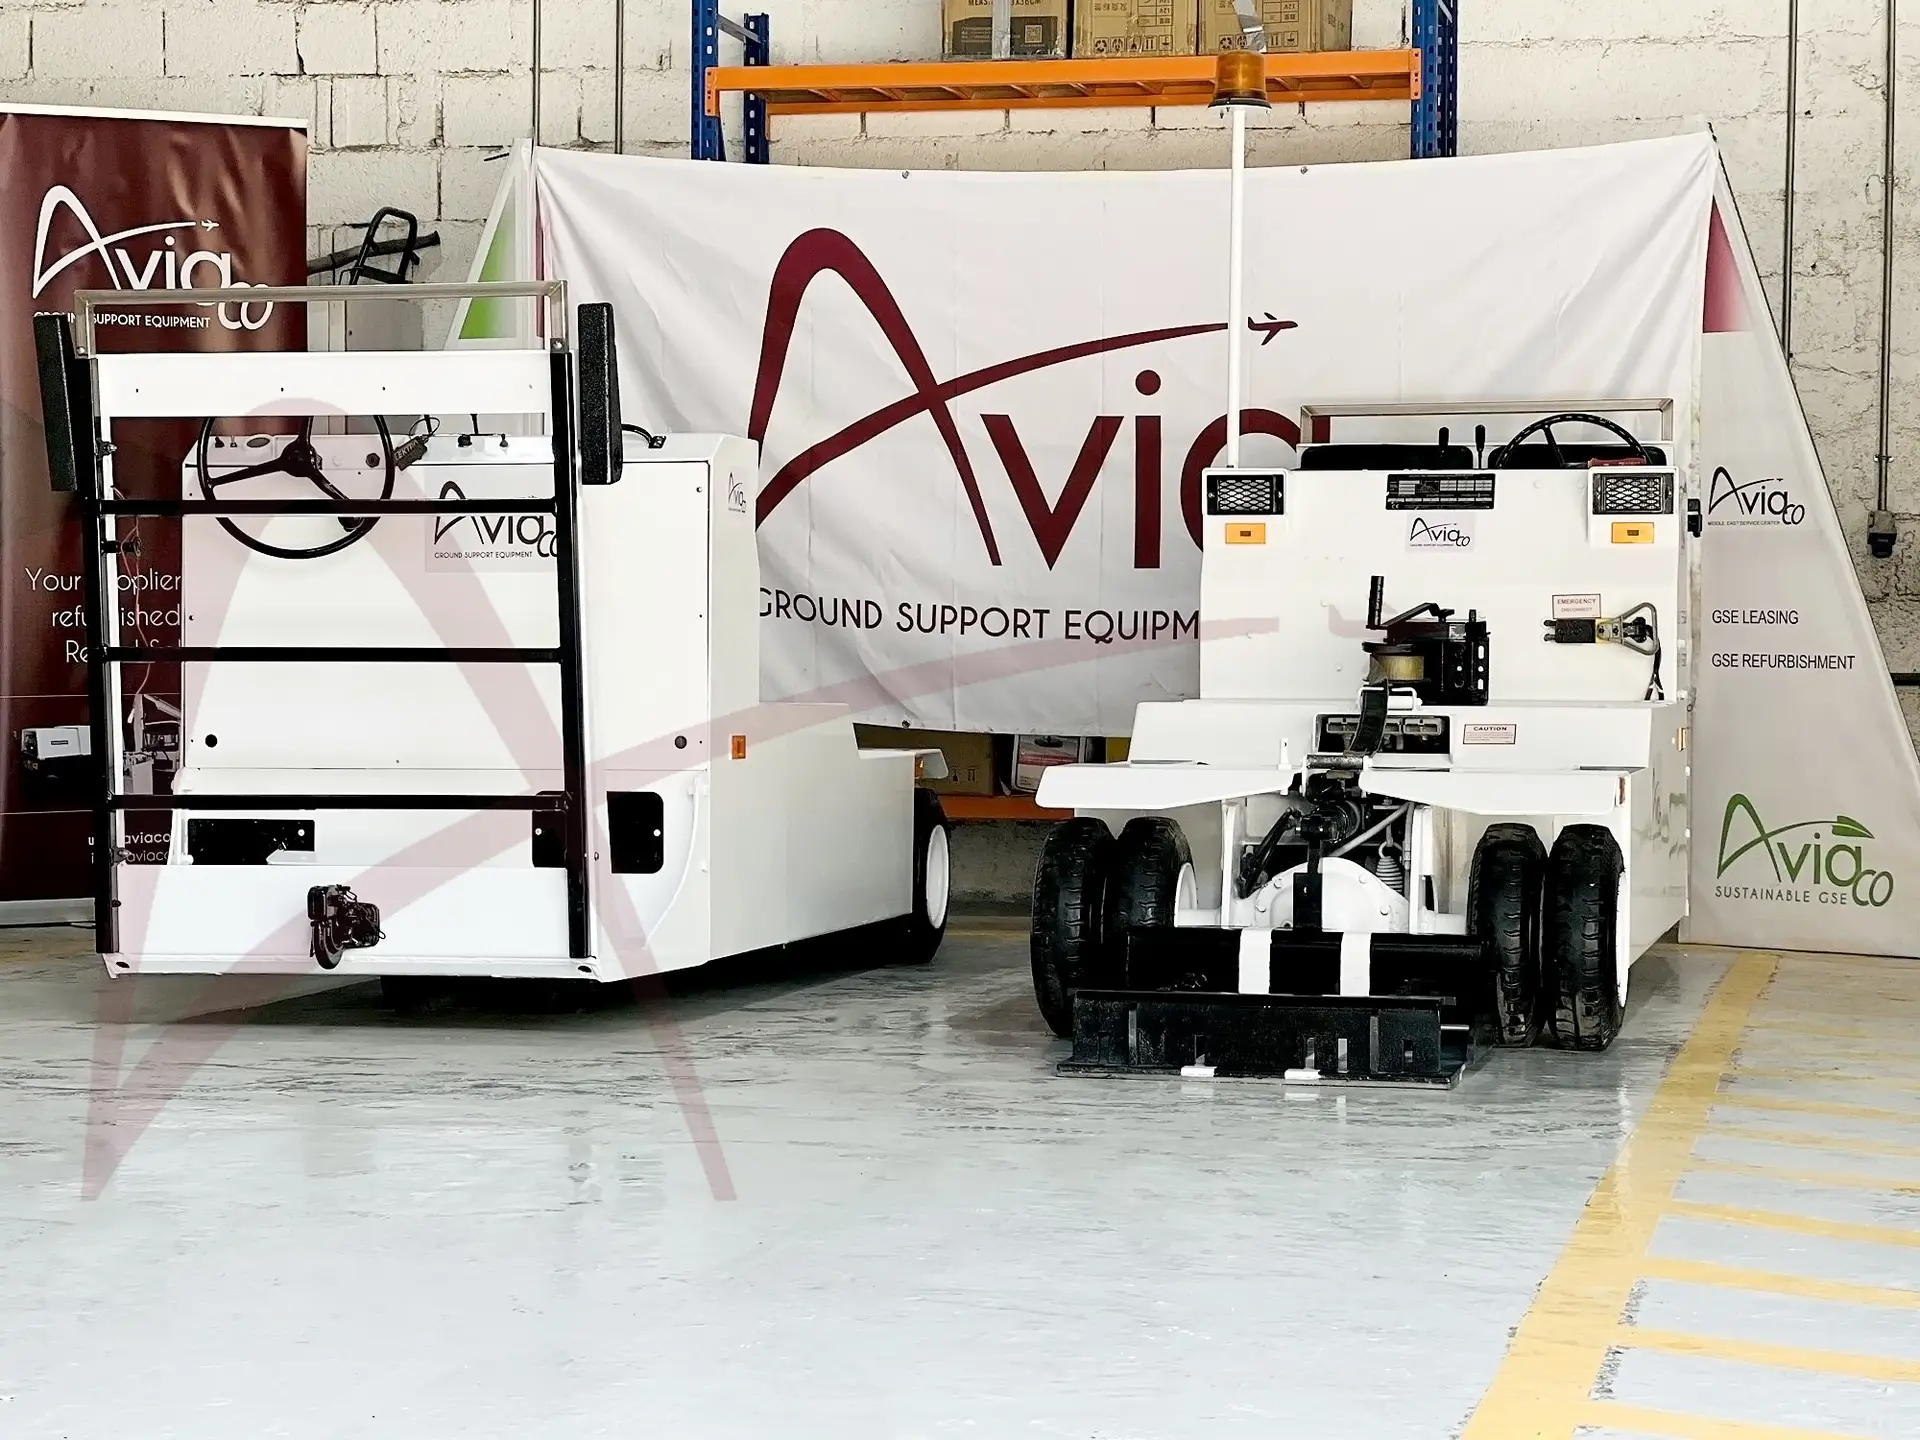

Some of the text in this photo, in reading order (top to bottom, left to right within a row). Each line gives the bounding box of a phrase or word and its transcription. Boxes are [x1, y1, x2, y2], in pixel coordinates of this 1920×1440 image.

[145, 314, 211, 329] EQUIPMENT
[1708, 466, 1805, 525] Aviaco
[1410, 517, 1471, 546] Aviaco
[434, 551, 533, 559] GROUND SUPPORT EQUIPMENT
[25, 567, 82, 591] Your
[759, 587, 882, 629] GROUND
[896, 602, 1051, 639] SUPPORT
[1712, 609, 1799, 624] GSE LEASING
[1711, 653, 1855, 669] GSE REFURBISHMENT
[1716, 793, 1894, 907] Aviaco
[1715, 885, 1847, 905] SUSTAINABLE GSE
